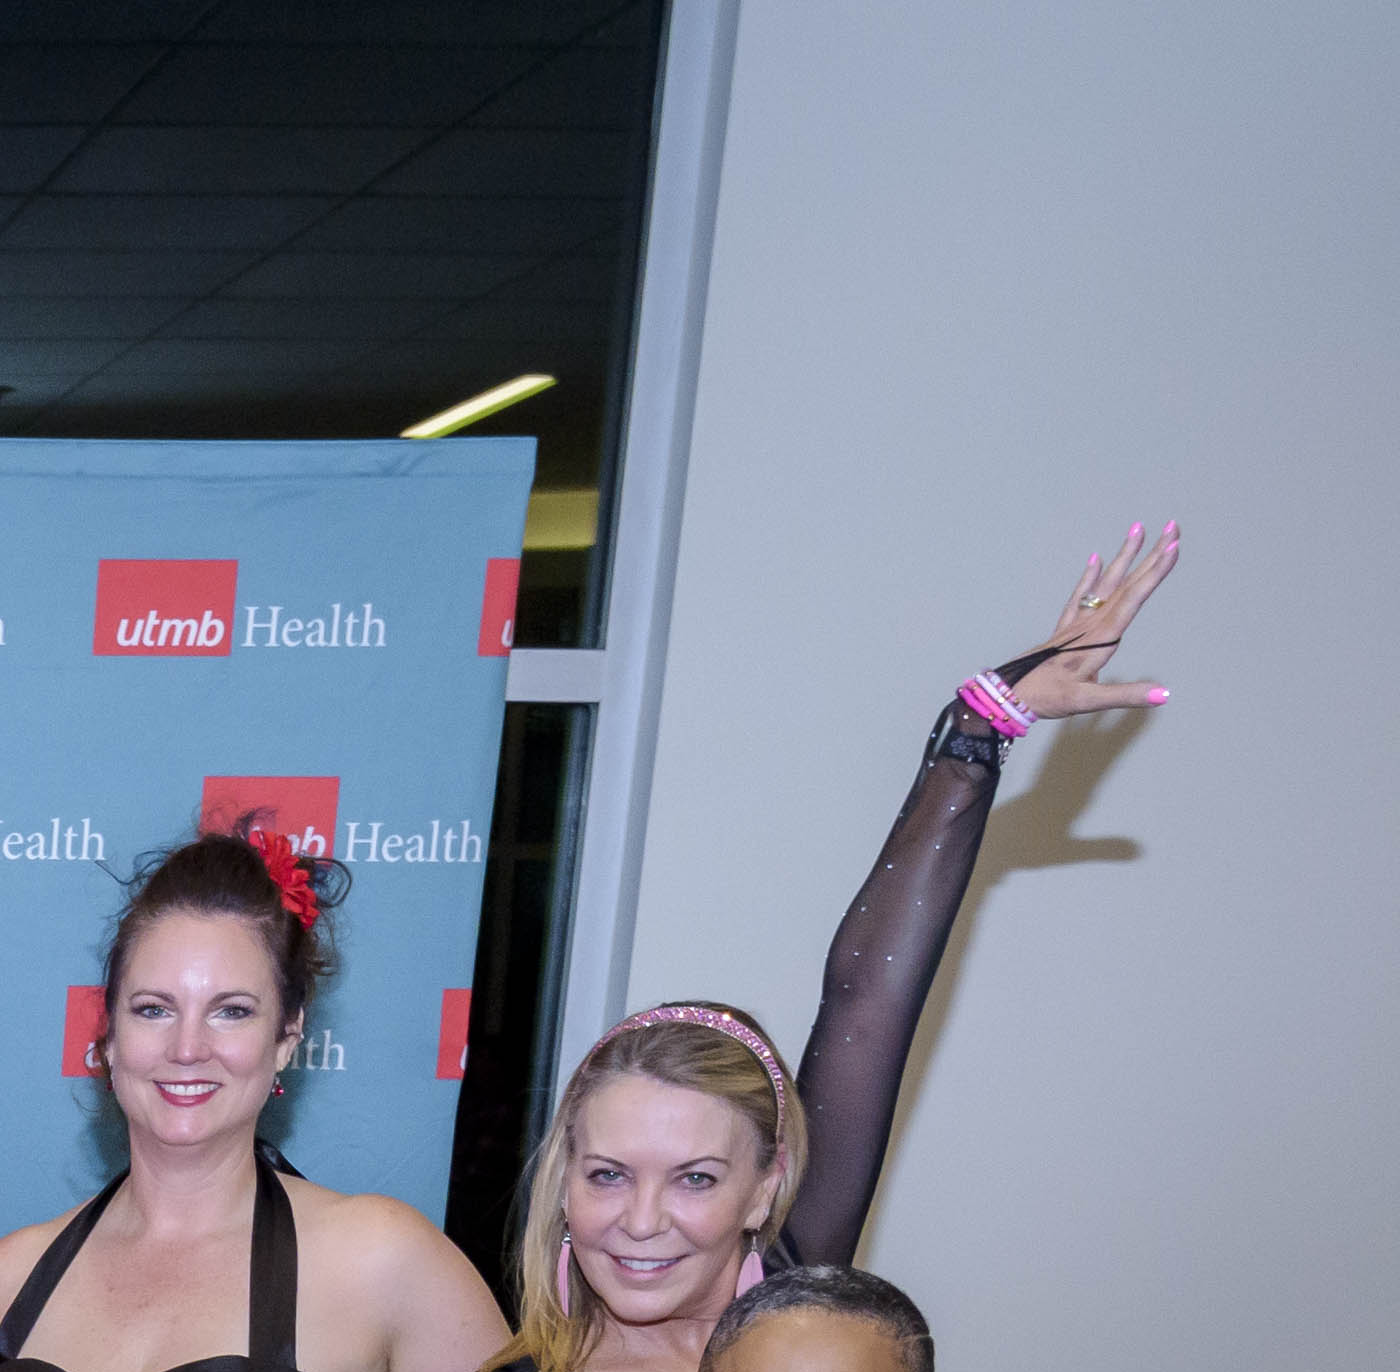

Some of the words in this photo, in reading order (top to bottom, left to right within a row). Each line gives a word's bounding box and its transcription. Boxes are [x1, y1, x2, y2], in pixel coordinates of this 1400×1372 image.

[116, 610, 225, 647] utmb
[242, 603, 385, 647] Health
[345, 820, 481, 863] Health
[291, 1029, 347, 1071] lth
